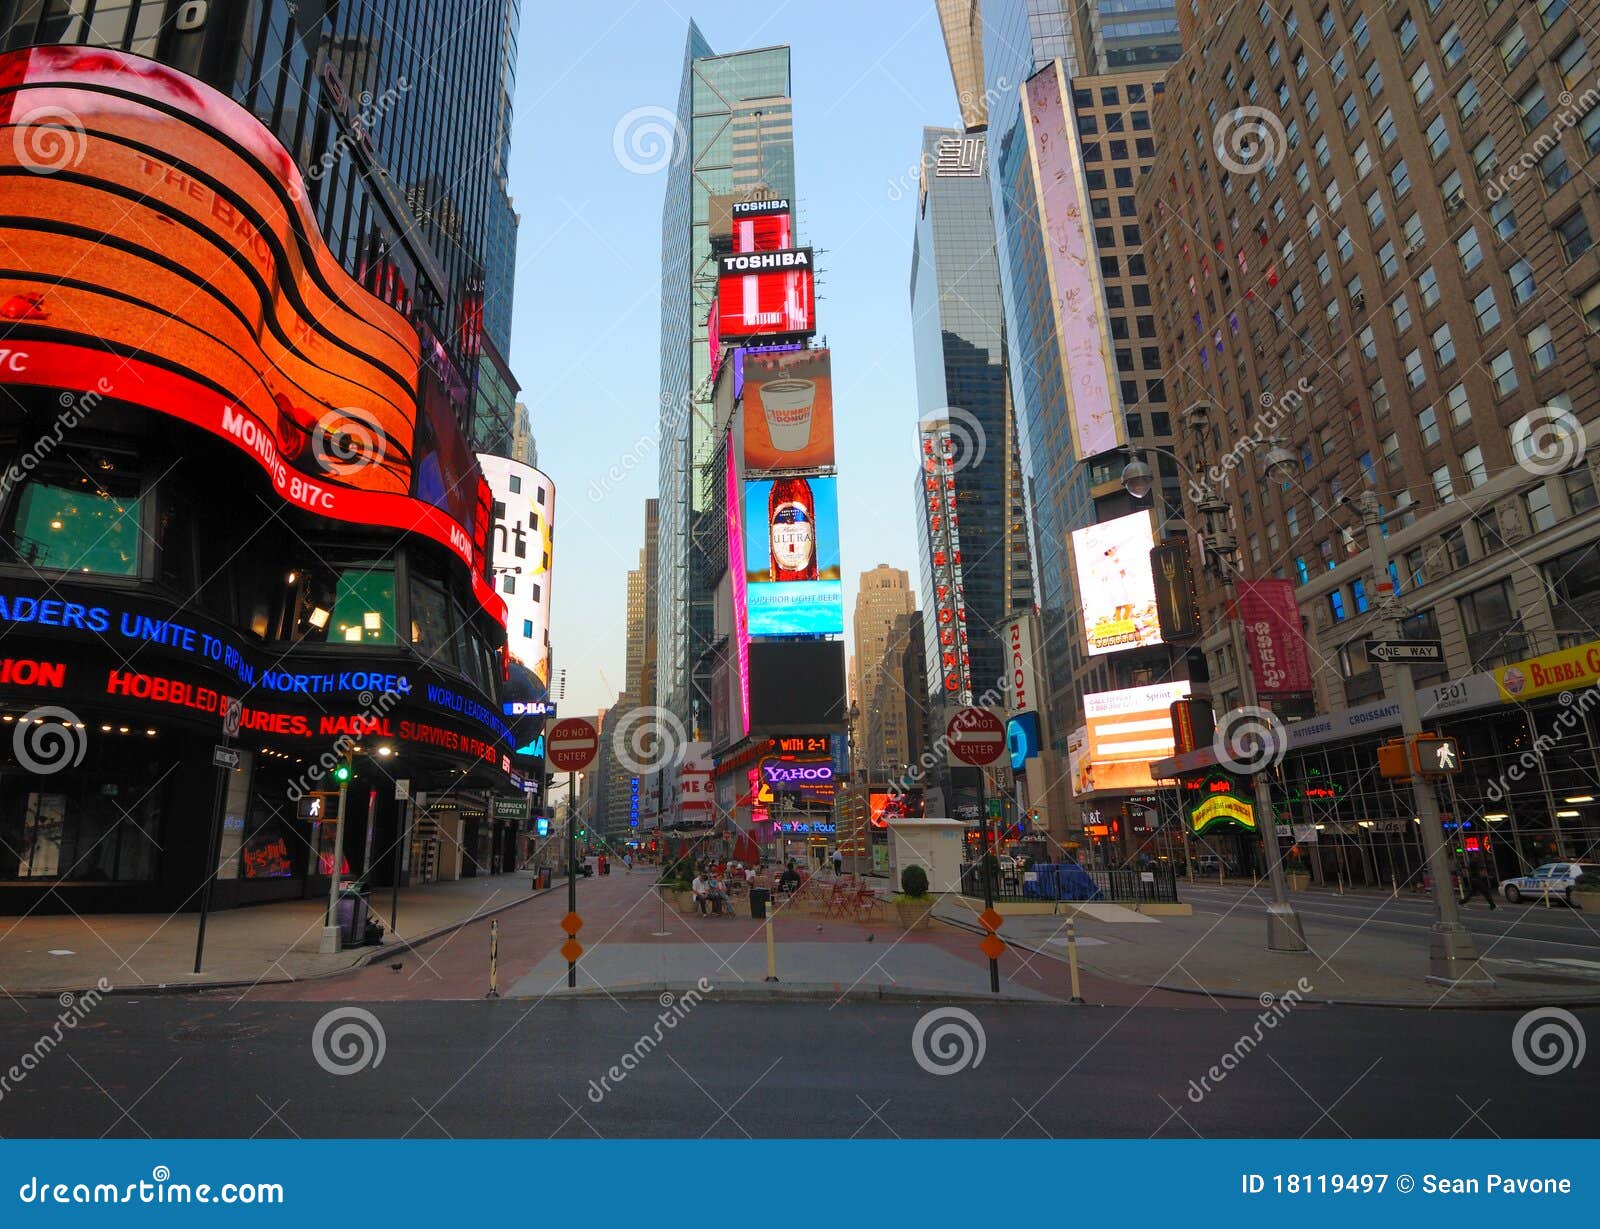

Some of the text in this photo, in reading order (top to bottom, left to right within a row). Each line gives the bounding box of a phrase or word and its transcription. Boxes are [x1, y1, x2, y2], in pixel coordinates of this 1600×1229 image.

[136, 154, 205, 202] THE
[734, 200, 788, 212] TOSHIBA
[724, 252, 808, 270] TOSHIBA
[222, 405, 287, 489] MONDAYS
[773, 533, 812, 543] ULTRA
[791, 594, 817, 603] LIGHT
[818, 594, 839, 602] BEER
[937, 585, 959, 691] YOUNG
[120, 612, 197, 652] UNITE
[201, 634, 223, 661] TO
[262, 668, 335, 694] NORTH
[338, 671, 411, 696] KOREA
[1377, 646, 1432, 656] ONE WAY
[1010, 624, 1026, 709] RICOH
[1530, 651, 1586, 689] BUBBA
[427, 683, 463, 712] WORLD
[1145, 691, 1171, 701] Sprint
[1432, 683, 1467, 703] 1501
[106, 670, 218, 713] HOBBLED
[240, 708, 312, 737] JURIES,
[319, 717, 394, 737] NADAL
[400, 720, 458, 750] SURVIVES
[556, 727, 589, 738] DO NOT
[1293, 722, 1332, 738] PATISSERIE
[780, 738, 826, 751] WITH 2-1
[960, 744, 994, 754] ENTER
[558, 752, 587, 761] ENTER
[764, 766, 832, 781] YAHOO
[494, 801, 527, 809] TARBUCKS
